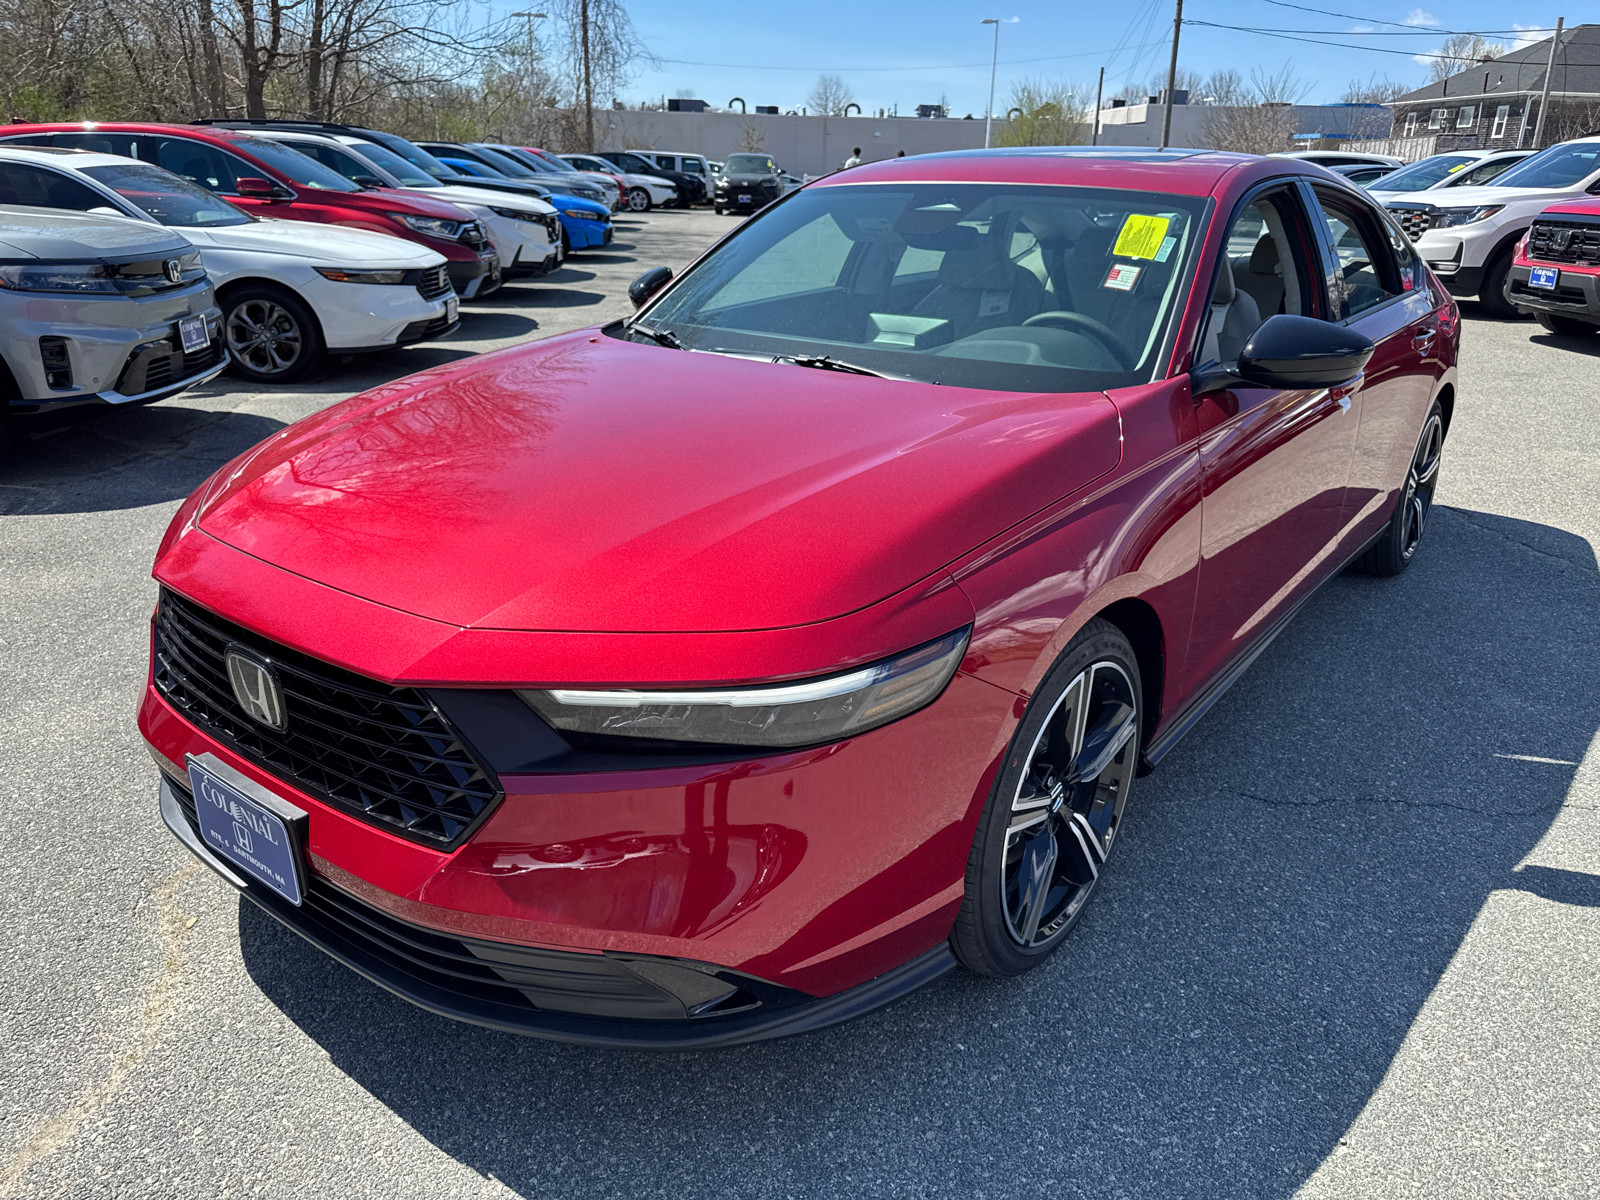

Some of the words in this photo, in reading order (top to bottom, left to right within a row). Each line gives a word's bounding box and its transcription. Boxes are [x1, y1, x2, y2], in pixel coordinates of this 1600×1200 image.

[201, 781, 279, 846] COLONIAL
[233, 844, 275, 879] DARTMOUTH,
[274, 872, 286, 886] MA
